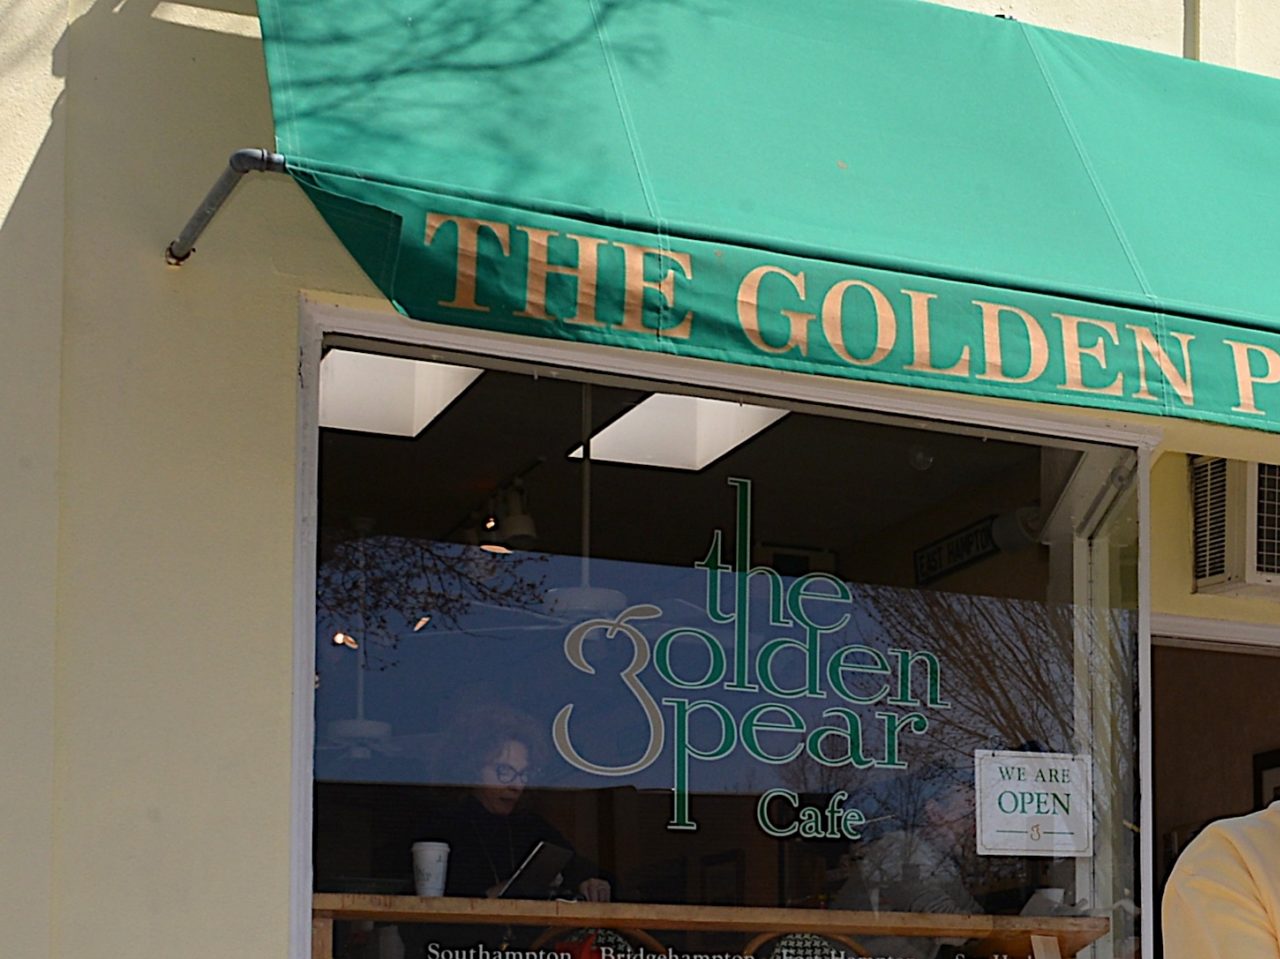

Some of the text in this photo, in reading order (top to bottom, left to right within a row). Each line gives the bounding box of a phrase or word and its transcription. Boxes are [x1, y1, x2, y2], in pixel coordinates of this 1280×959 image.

[424, 211, 694, 338] THE
[736, 265, 1195, 407] GOLDEN
[694, 477, 853, 634] the
[551, 603, 952, 778] golden
[661, 696, 930, 831] pear
[757, 787, 866, 840] Cafe
[998, 790, 1072, 816] OPEN
[999, 766, 1072, 783] WE ARE
